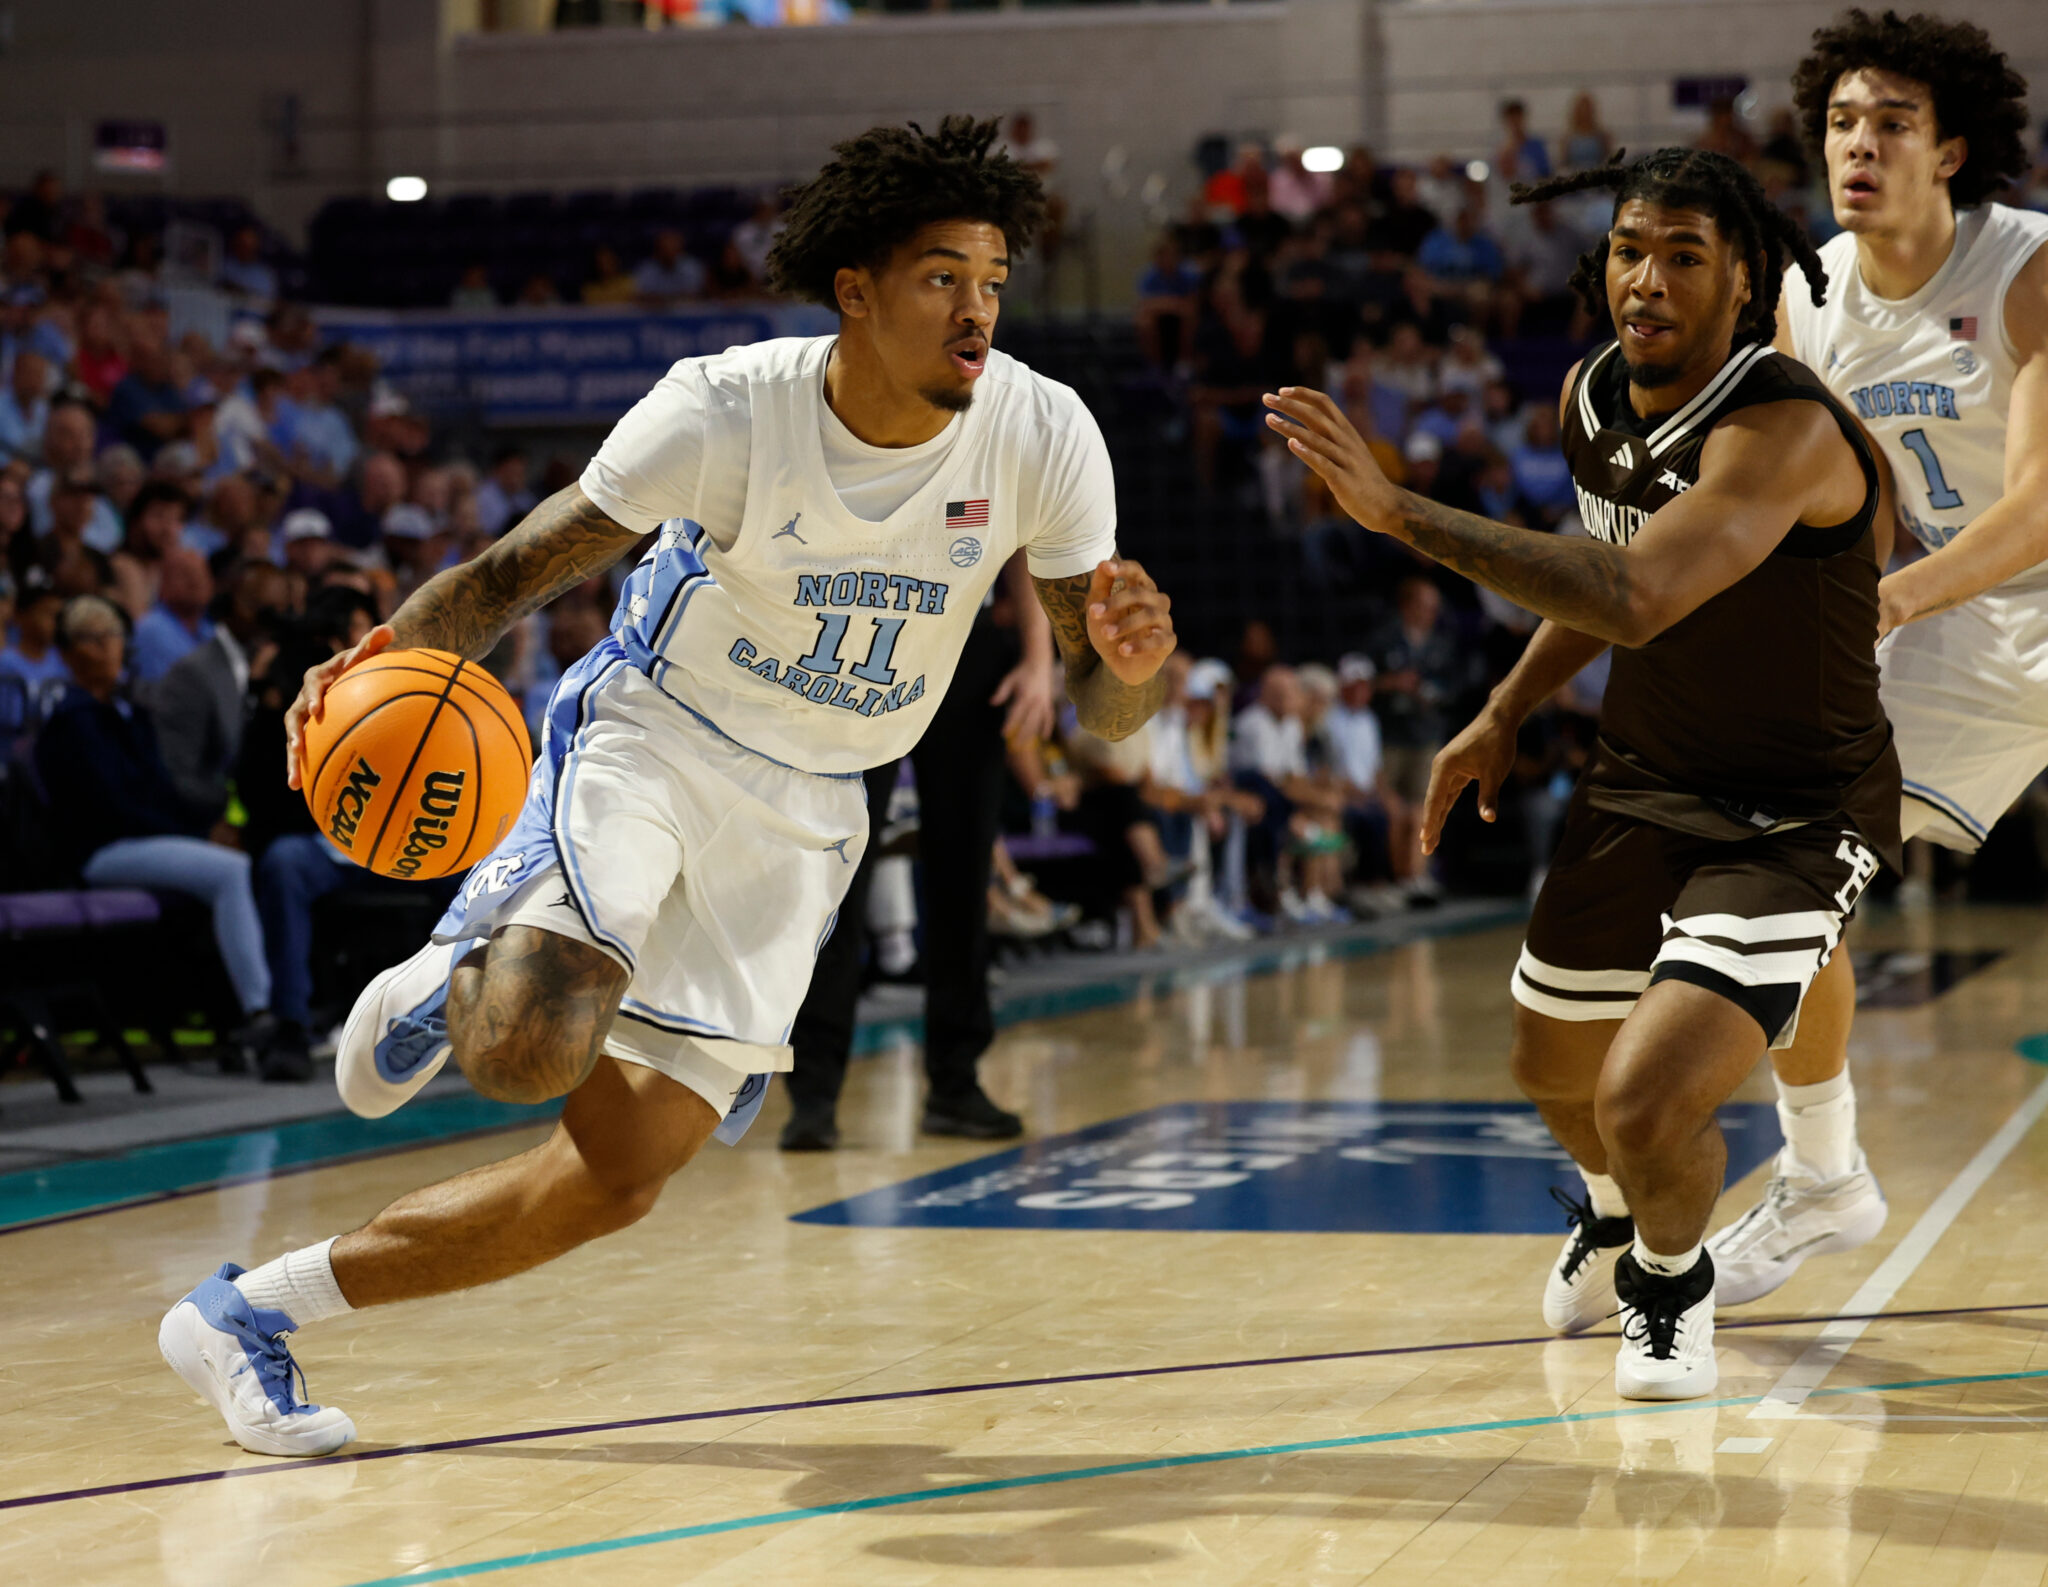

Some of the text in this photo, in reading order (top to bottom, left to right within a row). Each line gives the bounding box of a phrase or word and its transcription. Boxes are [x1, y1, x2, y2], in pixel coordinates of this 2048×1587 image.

[1850, 381, 1960, 420] NORTH
[1900, 428, 1964, 510] 1
[793, 571, 949, 615] NORTH
[727, 637, 926, 717] CAROLINA
[796, 612, 907, 685] 11
[330, 756, 382, 850] NCAA
[386, 769, 466, 878] Wilson
